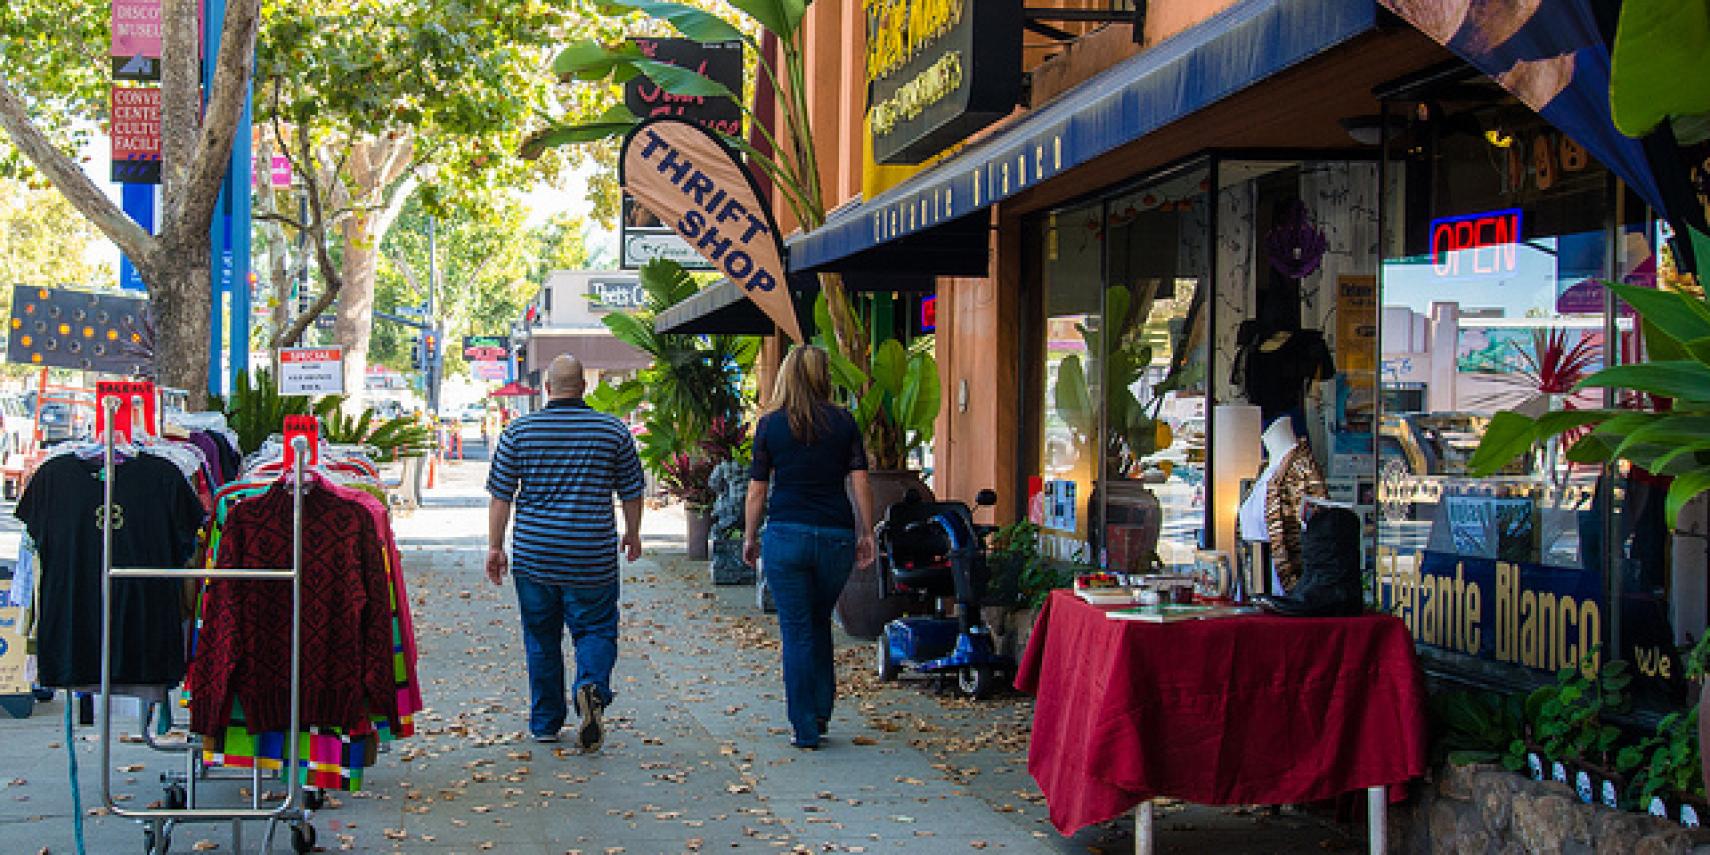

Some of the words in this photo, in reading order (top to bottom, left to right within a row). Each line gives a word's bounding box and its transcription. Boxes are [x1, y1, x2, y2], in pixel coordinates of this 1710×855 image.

[117, 5, 161, 19] DISCO
[117, 23, 161, 37] MUSEU
[115, 90, 161, 105] CONVE
[115, 106, 161, 121] CENTE
[115, 122, 161, 135] CULTU
[640, 129, 769, 249] THRIFT
[678, 210, 775, 292] SHOP
[1432, 214, 1518, 277] OPEN
[1376, 547, 1481, 656] Elefante
[1496, 560, 1600, 680] Blanco
